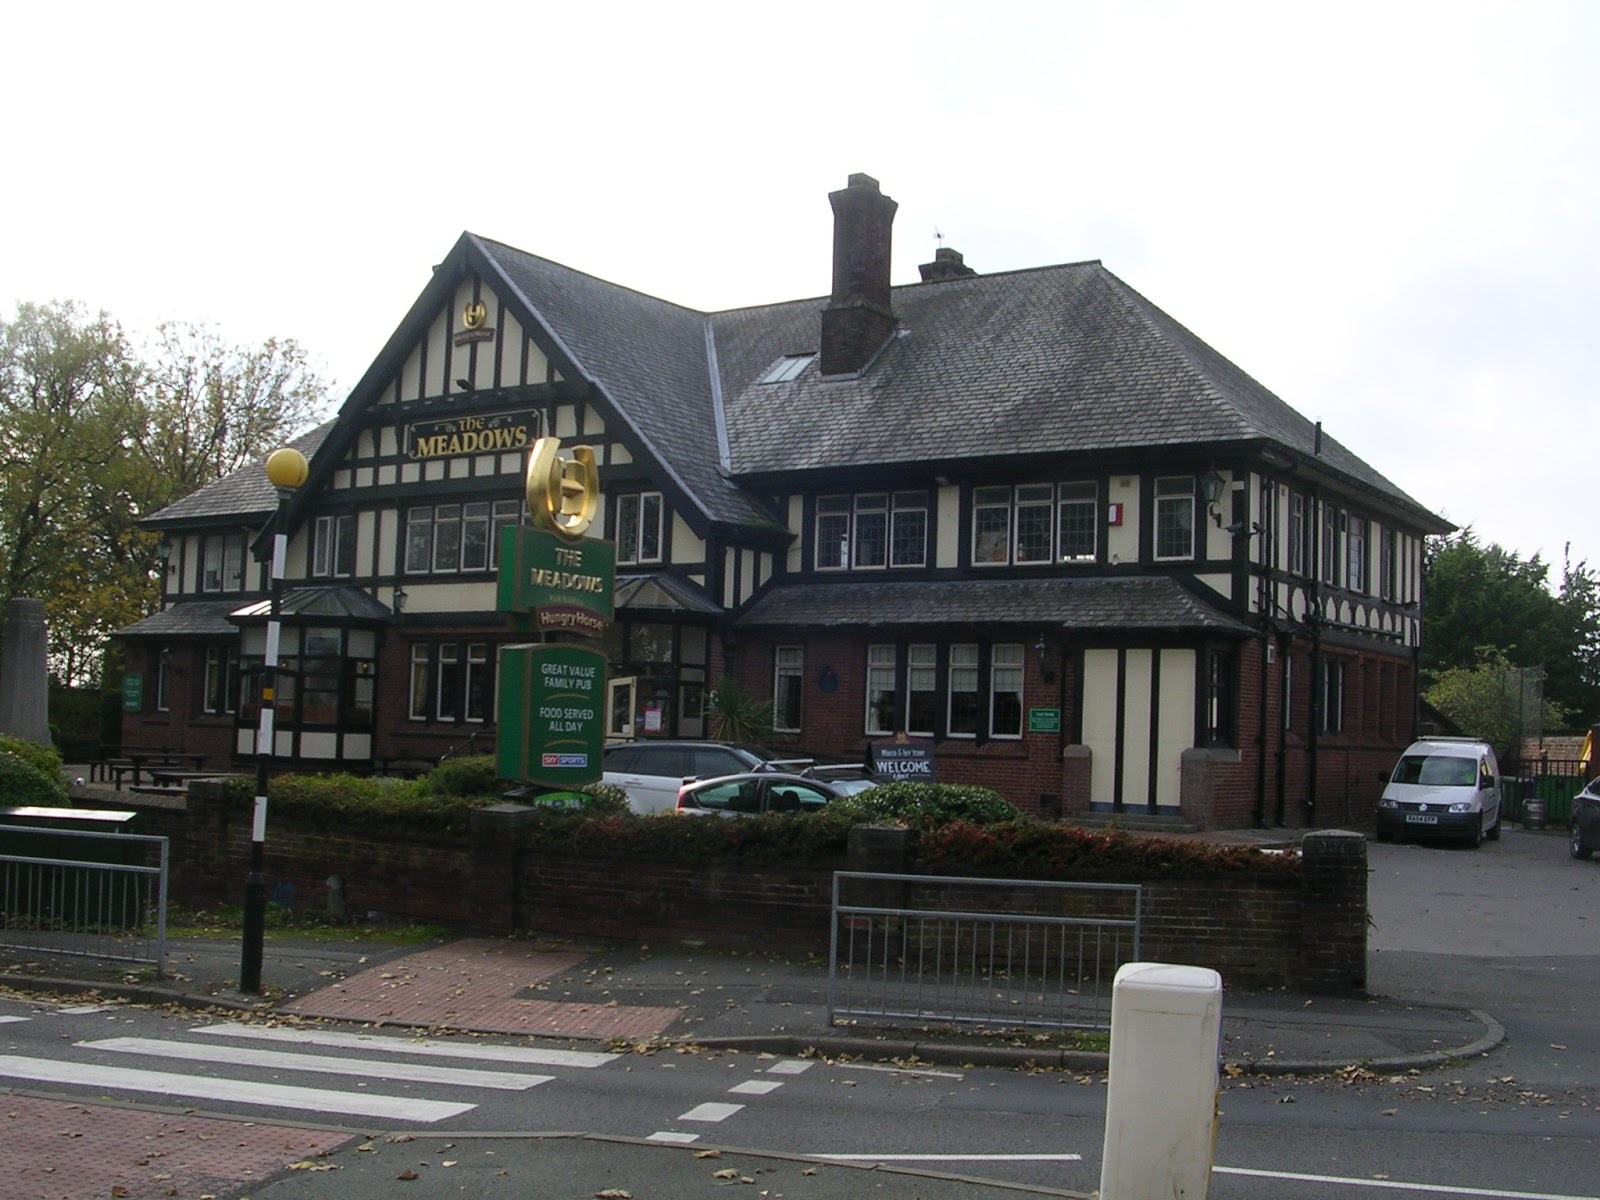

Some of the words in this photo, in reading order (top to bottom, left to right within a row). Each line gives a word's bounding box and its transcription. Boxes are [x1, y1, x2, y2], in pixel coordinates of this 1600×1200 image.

[416, 426, 527, 457] MEADOWS
[555, 547, 582, 567] THE
[531, 568, 603, 593] MEADOWS
[541, 663, 568, 675] GREAT
[569, 666, 595, 678] VALUE
[544, 676, 575, 689] FAMILY
[576, 679, 592, 690] PUB
[539, 707, 563, 718] FOOD
[564, 708, 594, 720] SERVED
[549, 720, 564, 732] ALL
[565, 721, 583, 732] DAY
[876, 761, 931, 773] WELCOME
